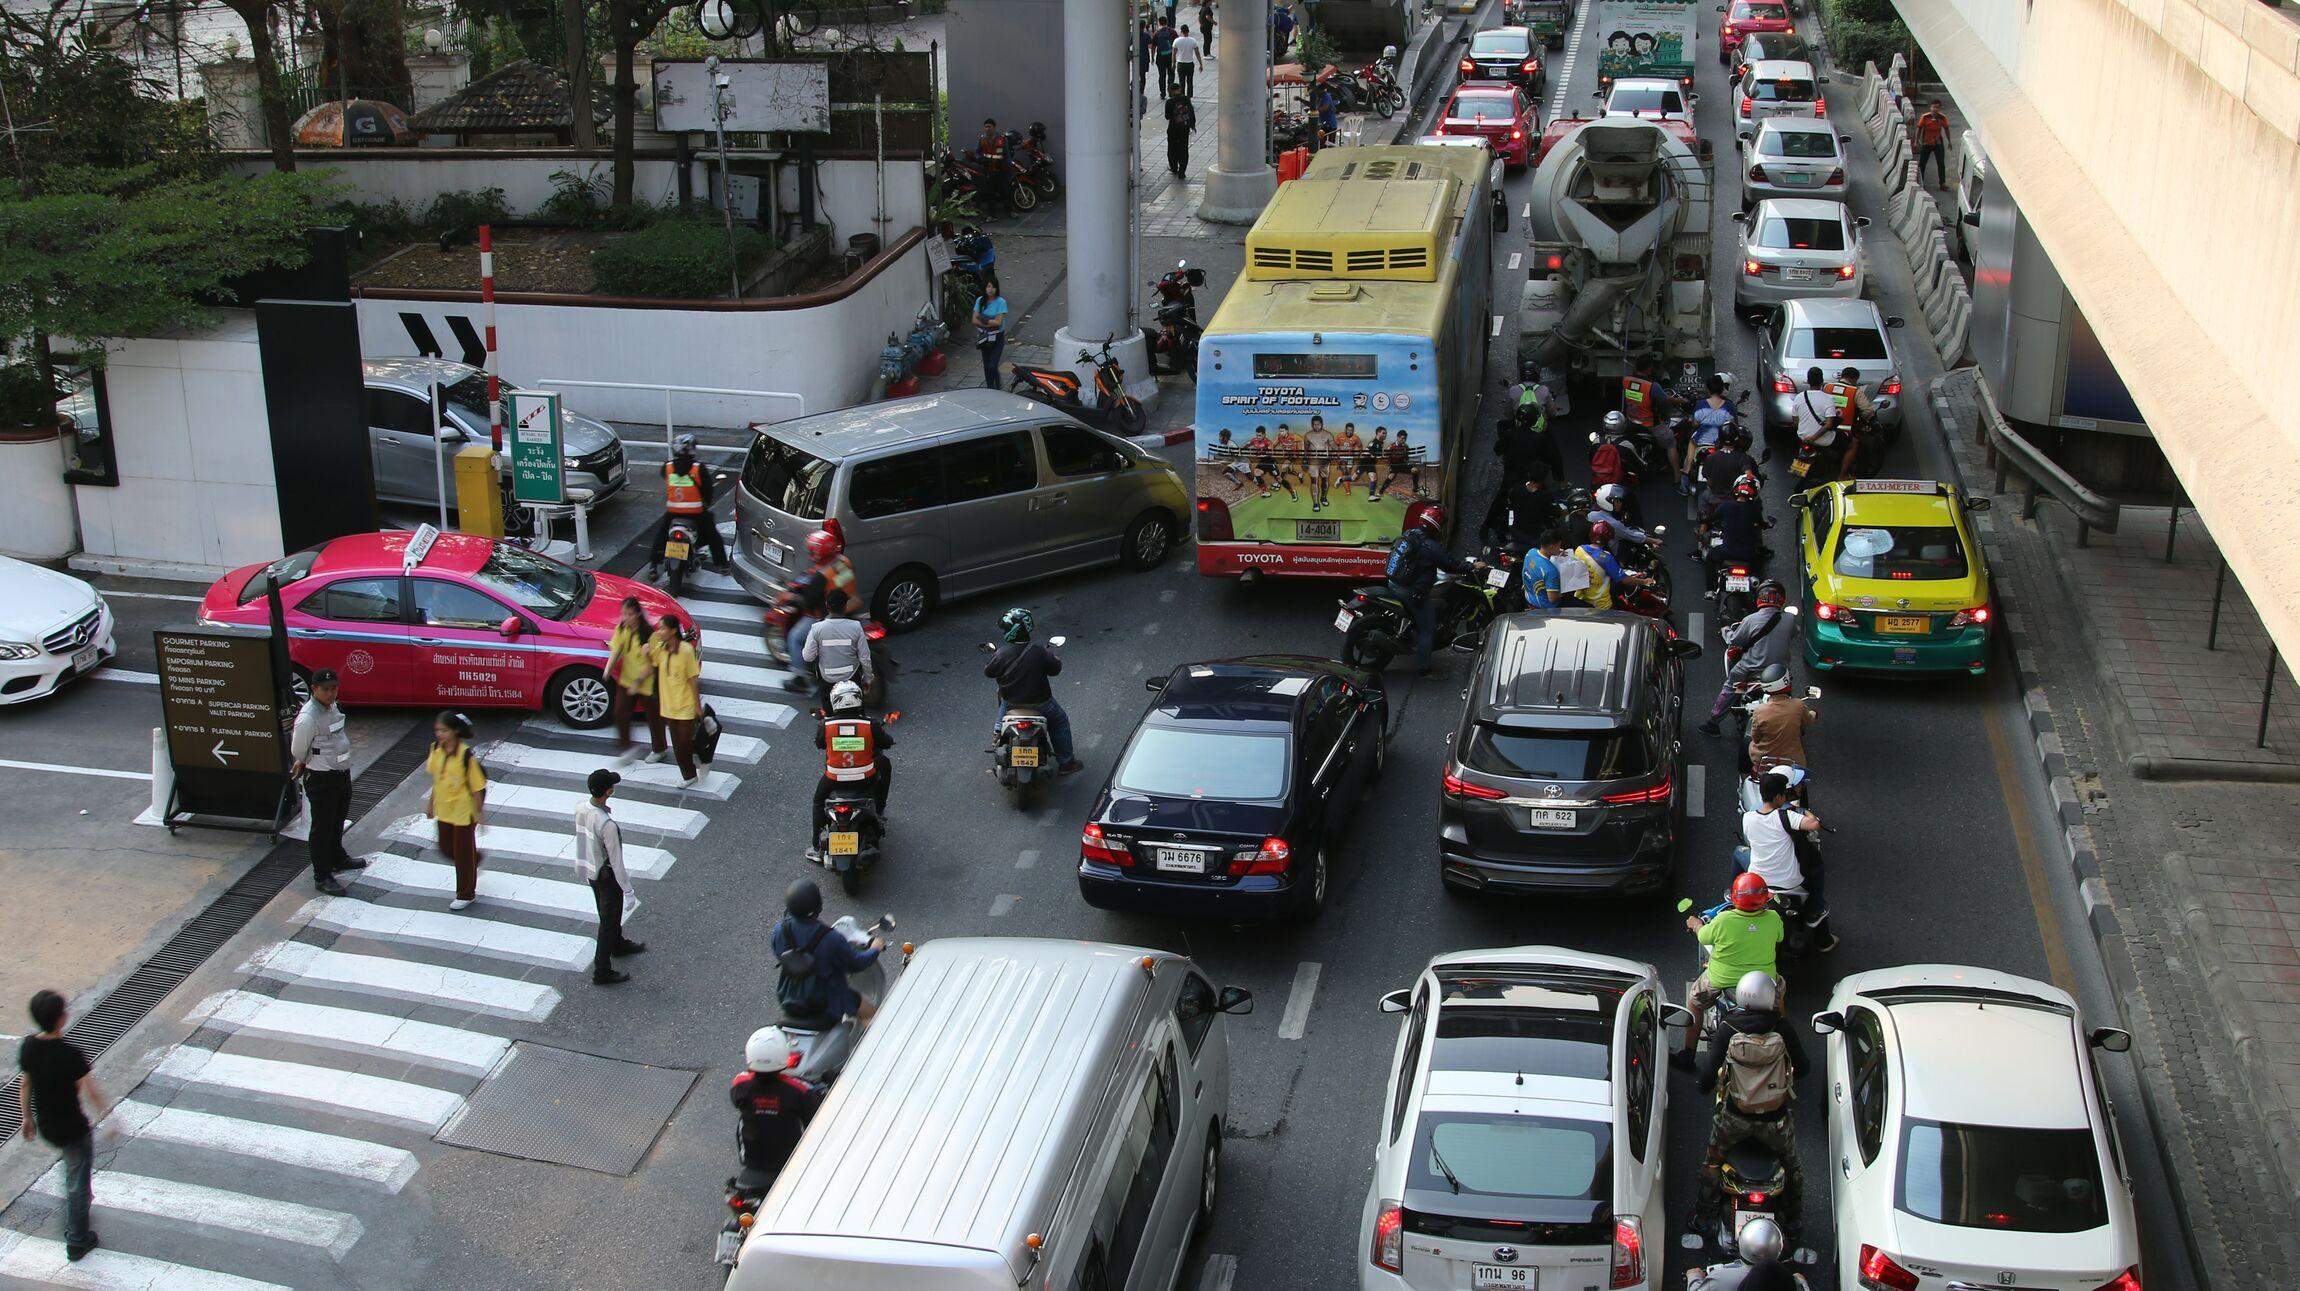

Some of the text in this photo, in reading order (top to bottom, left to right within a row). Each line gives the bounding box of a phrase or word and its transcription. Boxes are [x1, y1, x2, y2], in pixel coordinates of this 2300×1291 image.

[1680, 376, 1702, 384] ORC
[1258, 387, 1304, 396] TOYOTA
[1222, 396, 1341, 406] SPIRIT OF FOOTBALL
[527, 446, 544, 456] ระวัง
[541, 471, 553, 481] ปิด
[1866, 483, 1920, 491] TAXI-METER
[1300, 524, 1337, 536] 14-4041
[1236, 554, 1284, 563] TOYOTA
[1901, 618, 1920, 626] 2577
[162, 637, 231, 649] GOURMET PARKING
[166, 657, 235, 669] EMPORIUM PARKING
[508, 655, 525, 669] จำกัด
[168, 675, 226, 687] 90 MINS PARKING
[208, 700, 271, 712] SUPERCAR PARKING
[209, 709, 256, 719] VALET PARKING
[211, 727, 273, 739] PLATINUM PARKING
[842, 751, 854, 768] 3
[1555, 811, 1572, 820] 622
[1162, 851, 1202, 863] วม 6676
[1478, 1266, 1526, 1281] 1กน 96
